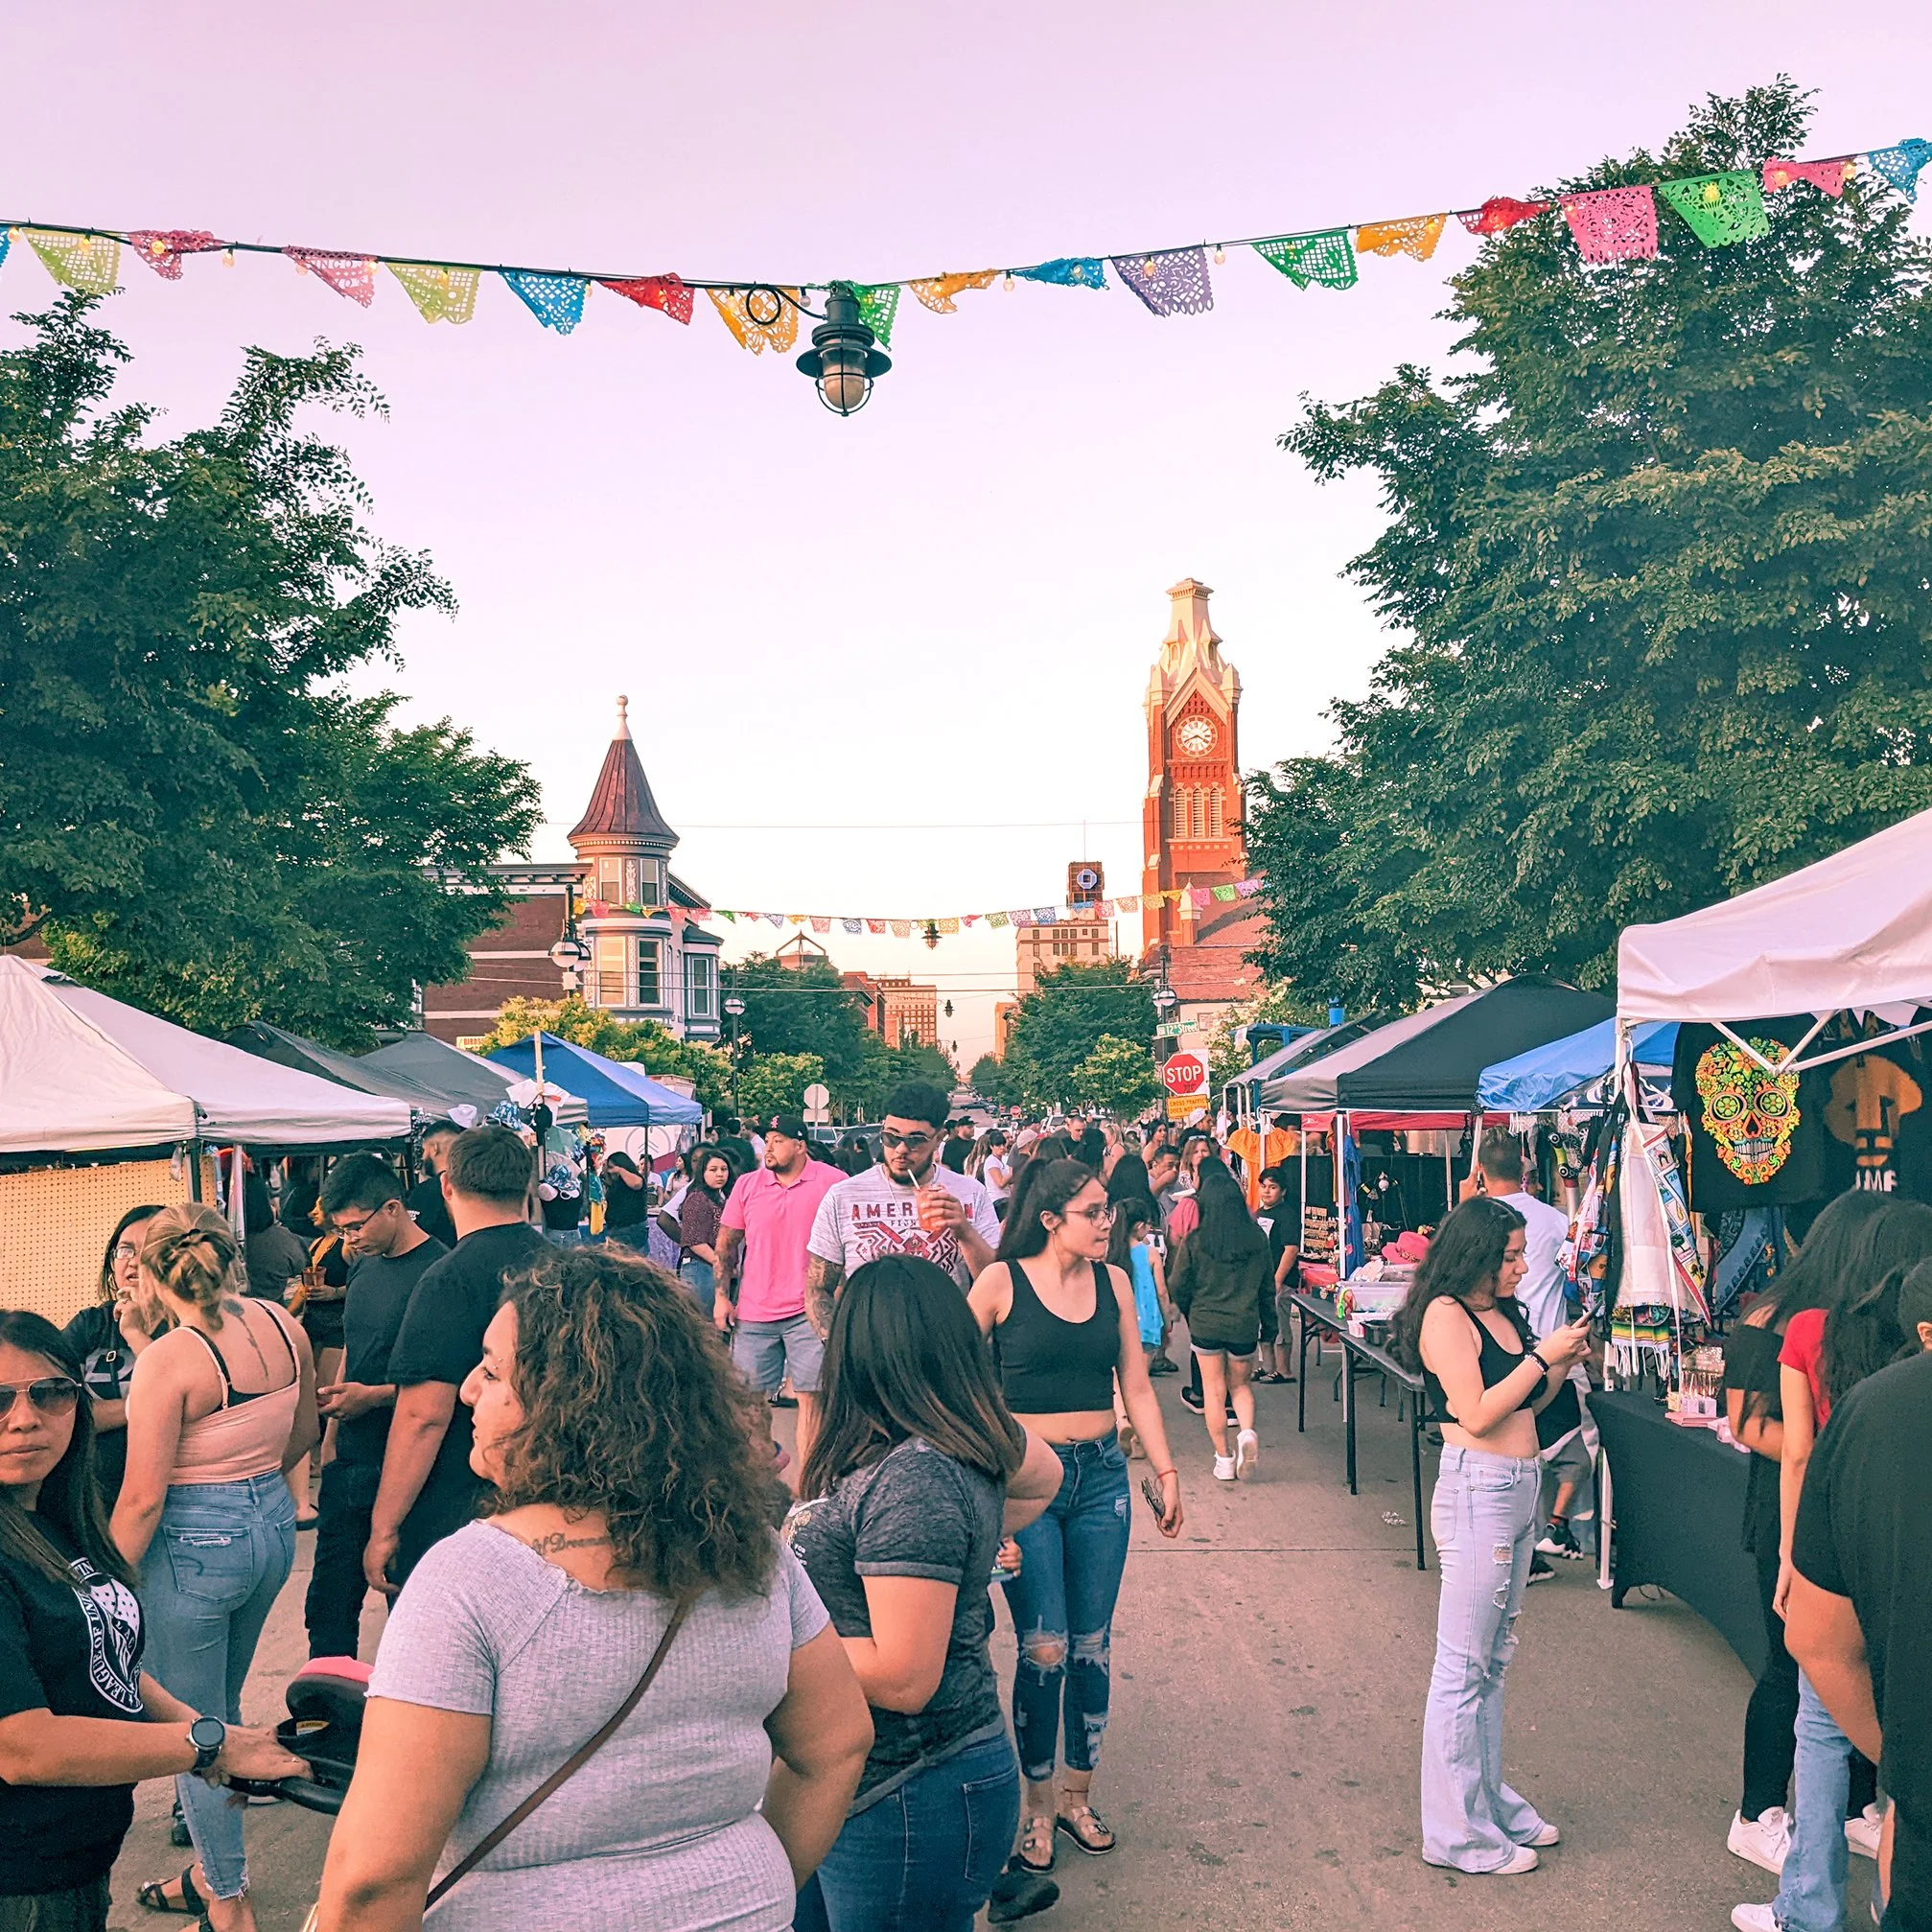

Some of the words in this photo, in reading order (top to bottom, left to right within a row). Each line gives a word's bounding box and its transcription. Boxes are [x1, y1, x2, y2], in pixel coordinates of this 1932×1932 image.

[1178, 1022, 1198, 1034] Street
[1167, 1065, 1201, 1083] STOP
[851, 1201, 973, 1221] AMERN
[92, 1626, 103, 1649] OF
[93, 1649, 127, 1704] LEAGUE
